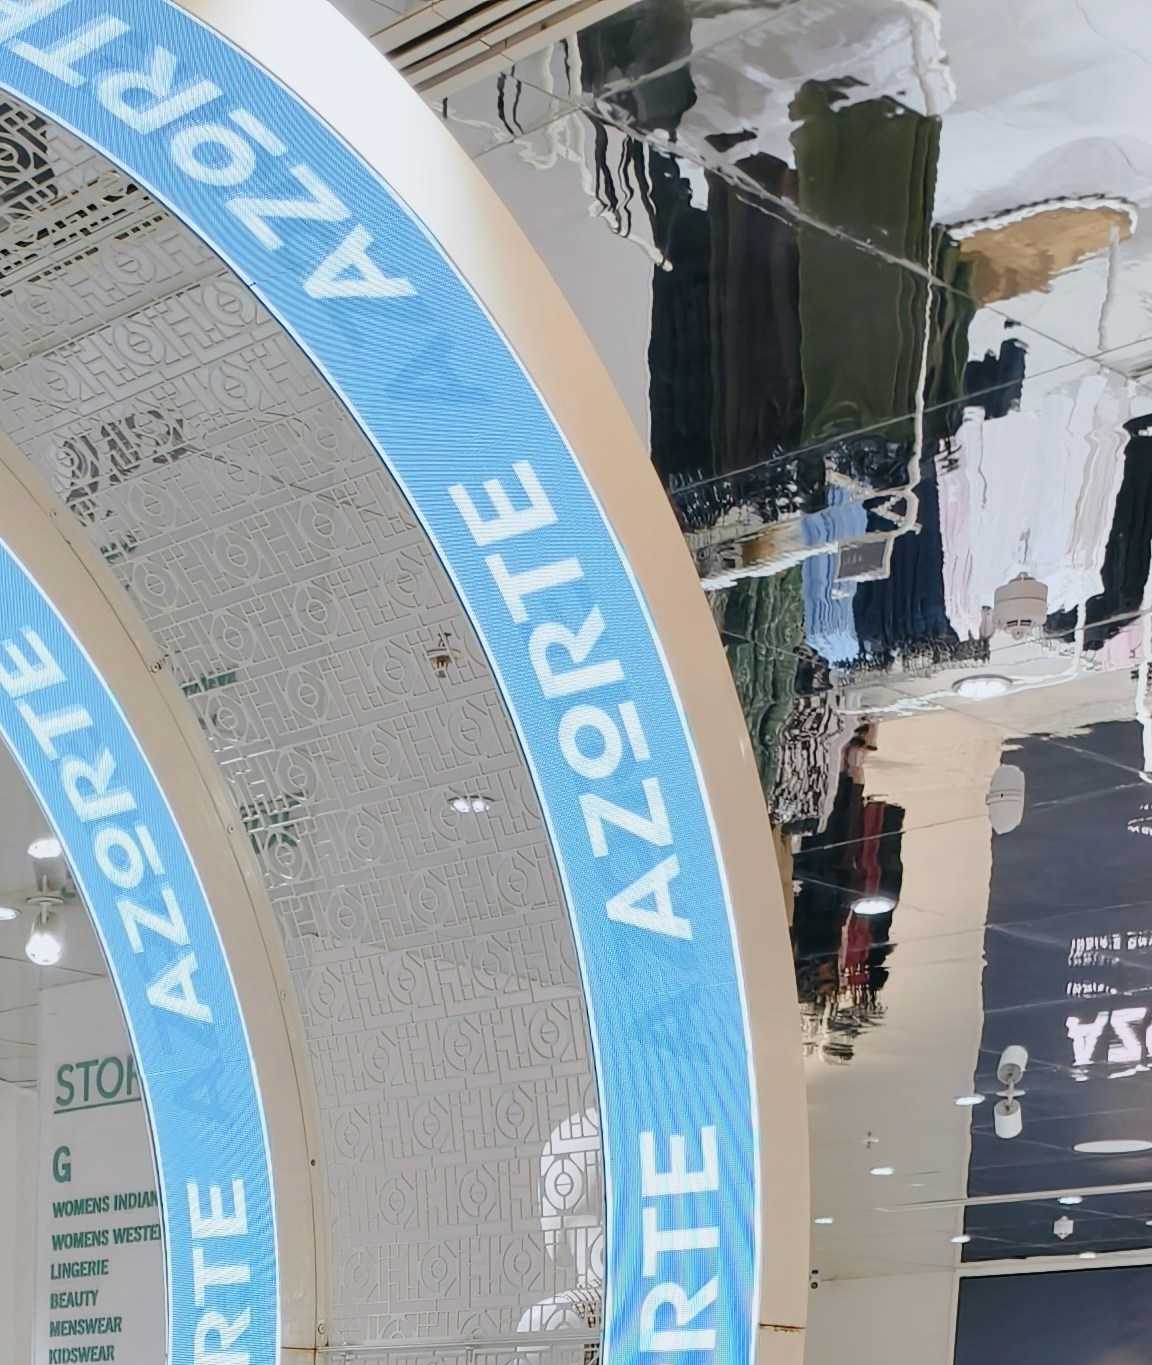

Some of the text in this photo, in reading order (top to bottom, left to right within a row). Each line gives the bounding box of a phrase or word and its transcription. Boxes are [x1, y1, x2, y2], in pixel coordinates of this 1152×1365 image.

[447, 460, 693, 940] AZORTE
[52, 1146, 71, 1183] G
[52, 1195, 110, 1219] WOMENS
[51, 1224, 161, 1251] WOMENS WESTE
[50, 1259, 109, 1281] LINGERIE
[50, 1289, 99, 1310] BEAUTY
[49, 1316, 122, 1338] MENSWEAR
[48, 1345, 115, 1365] KIDSWEAR
